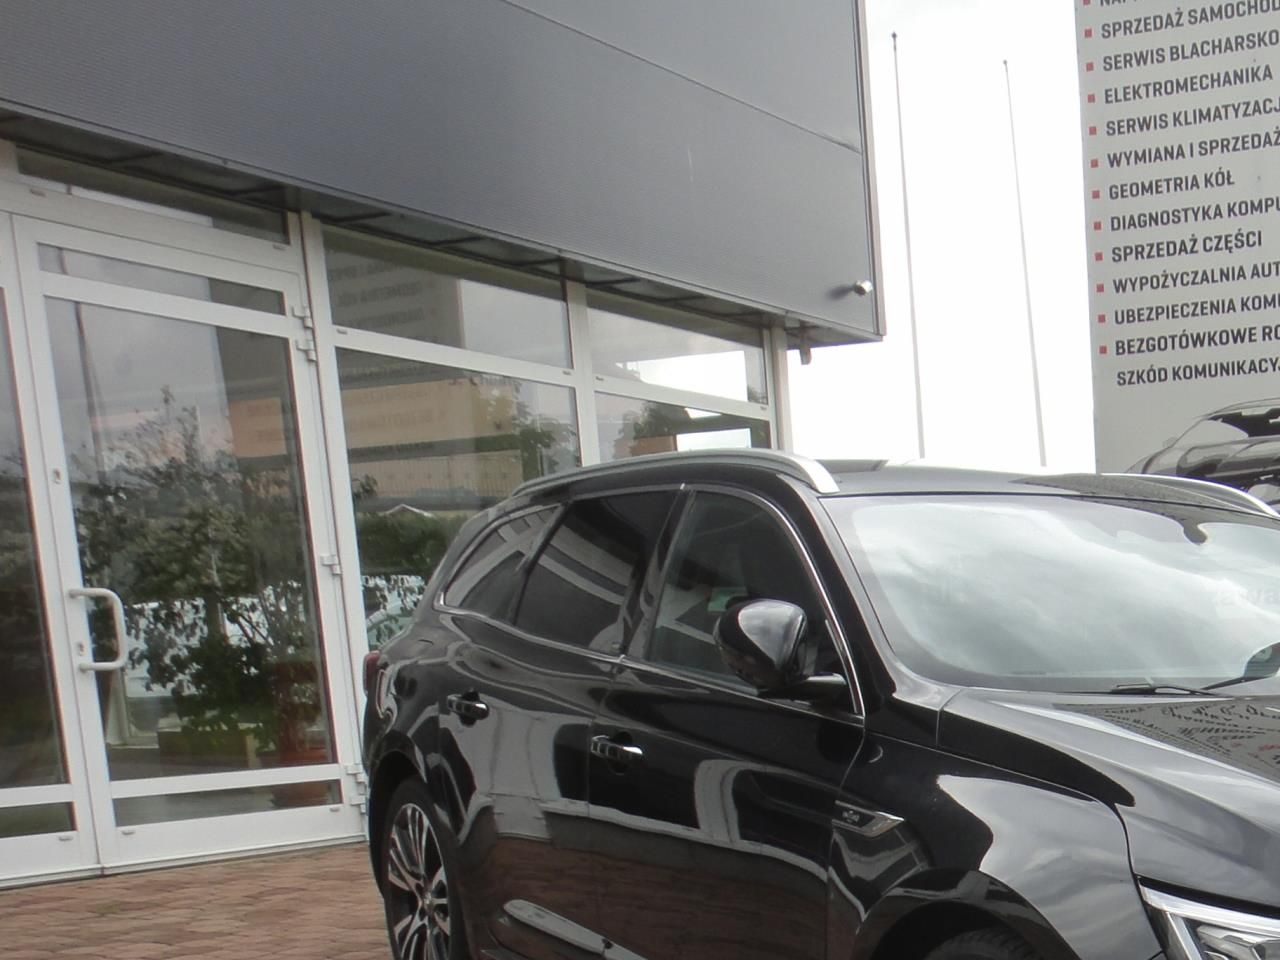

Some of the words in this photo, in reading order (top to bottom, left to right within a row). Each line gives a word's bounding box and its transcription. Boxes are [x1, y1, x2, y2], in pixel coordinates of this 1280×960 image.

[1101, 7, 1184, 39] SPRZEDAŻ
[1103, 47, 1166, 72] SERWIS
[1104, 64, 1273, 104] ELEKTROMECHANIKA
[1106, 113, 1168, 137] SERWIS
[1107, 143, 1185, 169] WYMIANA
[1190, 142, 1194, 158] I
[1109, 174, 1200, 200] GEOMETRIA
[1204, 169, 1235, 189] KÓŁ
[1110, 206, 1223, 232] DIAGNOSTYKA
[1112, 234, 1199, 263] SPRZEDAŻ
[1203, 228, 1263, 254] CZĘŚCI
[1113, 265, 1247, 294] WYPOŻYCZALNIA
[1114, 298, 1237, 325] UBEZPIECZENIA
[1115, 325, 1257, 356] BEZGOTÓWKOWE
[1116, 364, 1168, 386] SZKÓD
